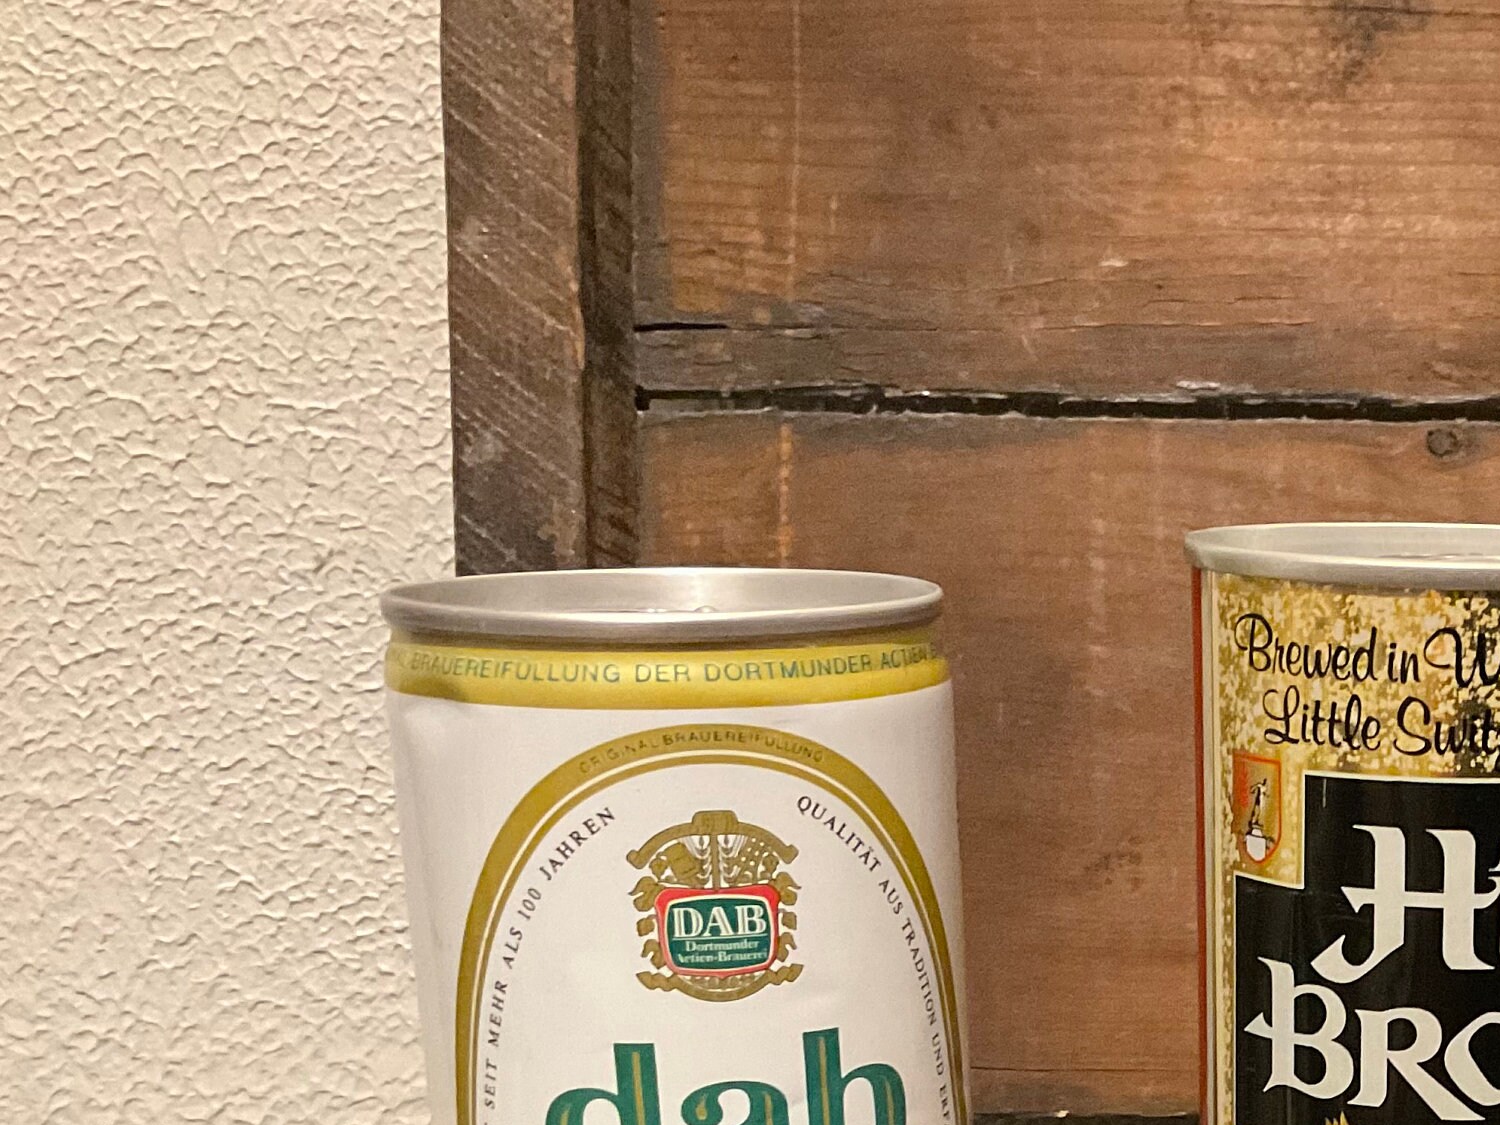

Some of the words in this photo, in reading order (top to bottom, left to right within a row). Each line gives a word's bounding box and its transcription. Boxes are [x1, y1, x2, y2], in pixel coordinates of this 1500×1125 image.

[635, 663, 691, 683] DER
[704, 654, 873, 682] DORTMUNDER
[1234, 613, 1378, 682] Brewed
[1387, 642, 1421, 684] in
[1262, 685, 1381, 751] Little
[539, 807, 616, 881] JAHREN
[517, 887, 542, 921] 100
[673, 904, 767, 938] DAB
[502, 926, 523, 970] ALS
[797, 796, 882, 873] QUALITÄT
[878, 879, 904, 915] AUS
[901, 917, 938, 1026] TRADITION
[931, 1033, 944, 1076] UND
[488, 980, 508, 1048] MEHR
[484, 1058, 499, 1110] SEIT
